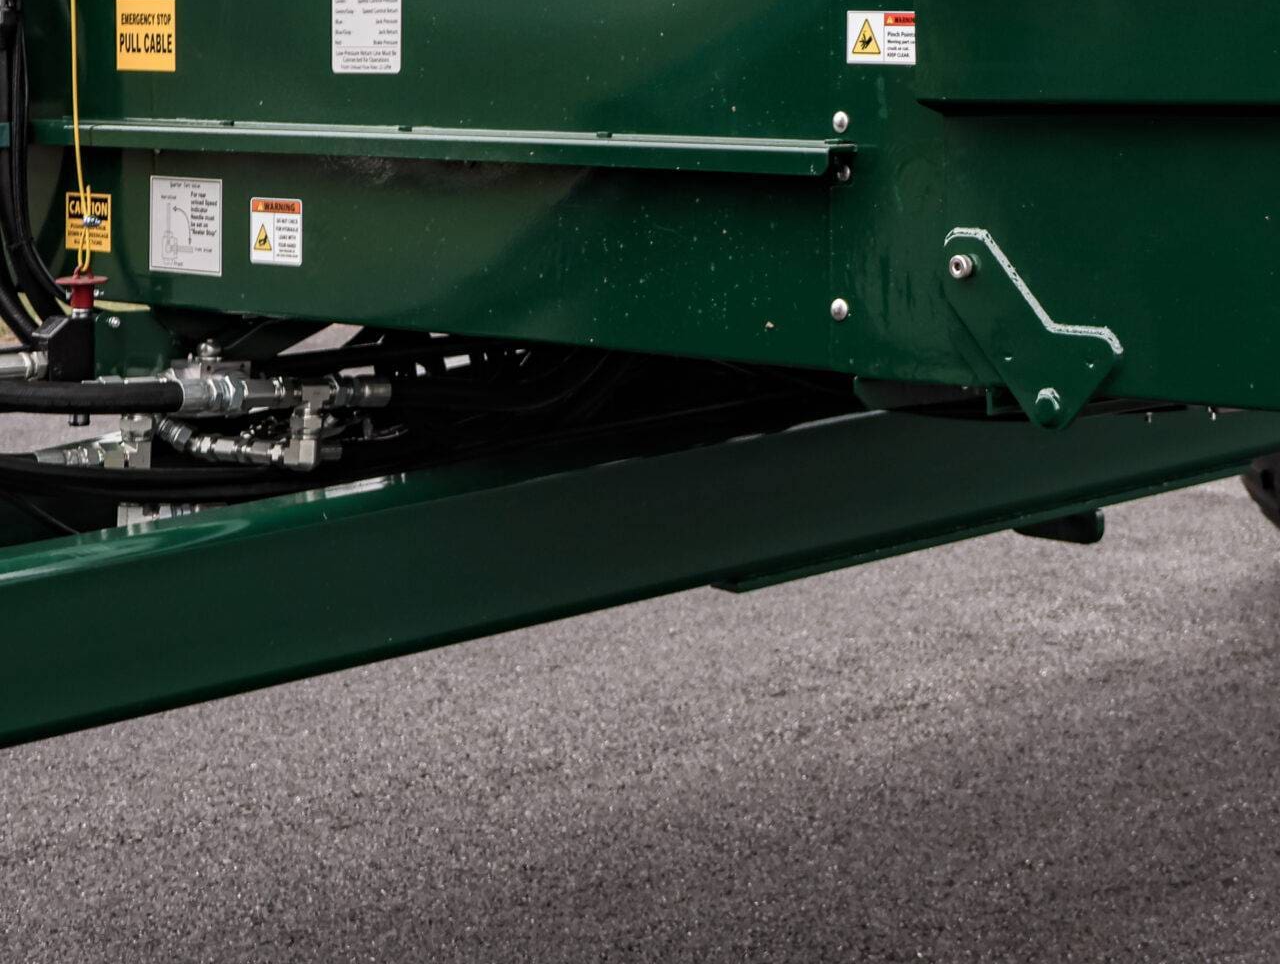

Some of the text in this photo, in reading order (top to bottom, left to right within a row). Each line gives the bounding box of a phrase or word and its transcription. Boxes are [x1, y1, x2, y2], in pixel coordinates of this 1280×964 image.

[121, 13, 172, 26] EMERGENCY STOP
[119, 33, 172, 53] PULL CABLE
[264, 202, 296, 212] WARNING
